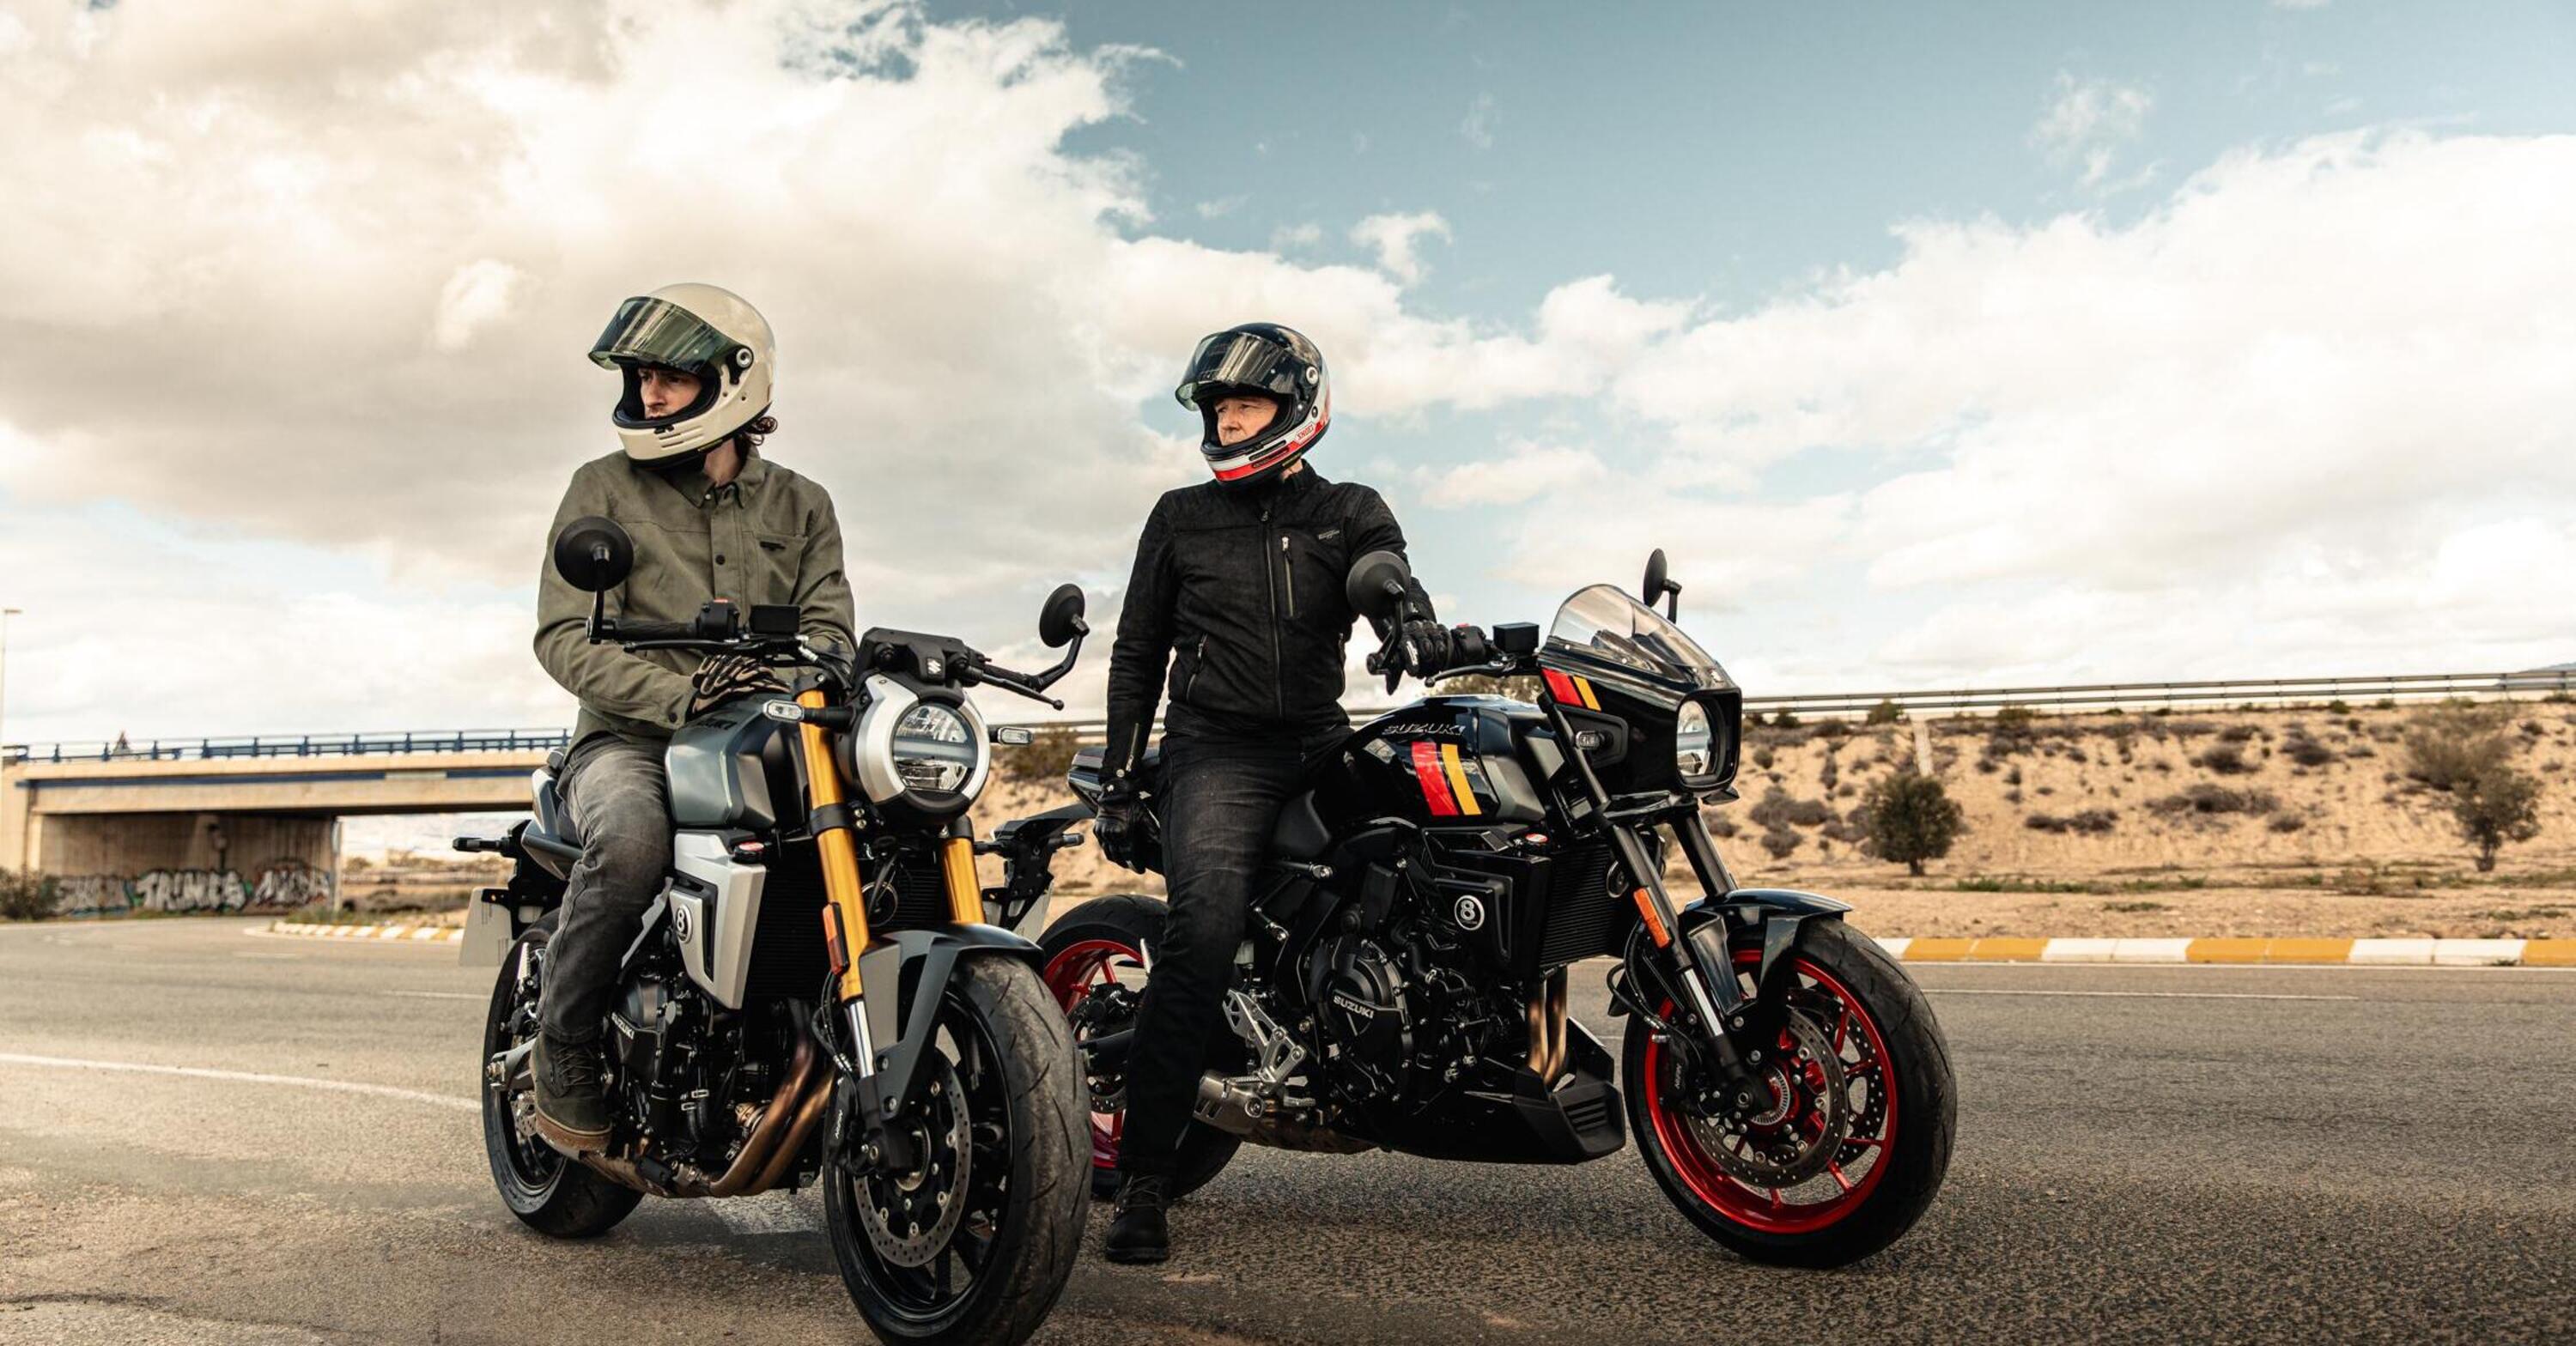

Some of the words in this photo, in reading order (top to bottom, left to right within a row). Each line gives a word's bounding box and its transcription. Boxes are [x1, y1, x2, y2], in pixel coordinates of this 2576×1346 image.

[1382, 724, 1466, 736] SUZUKI
[676, 910, 685, 933] 8
[1460, 900, 1475, 921] 8
[1333, 995, 1374, 1019] SUZUKI
